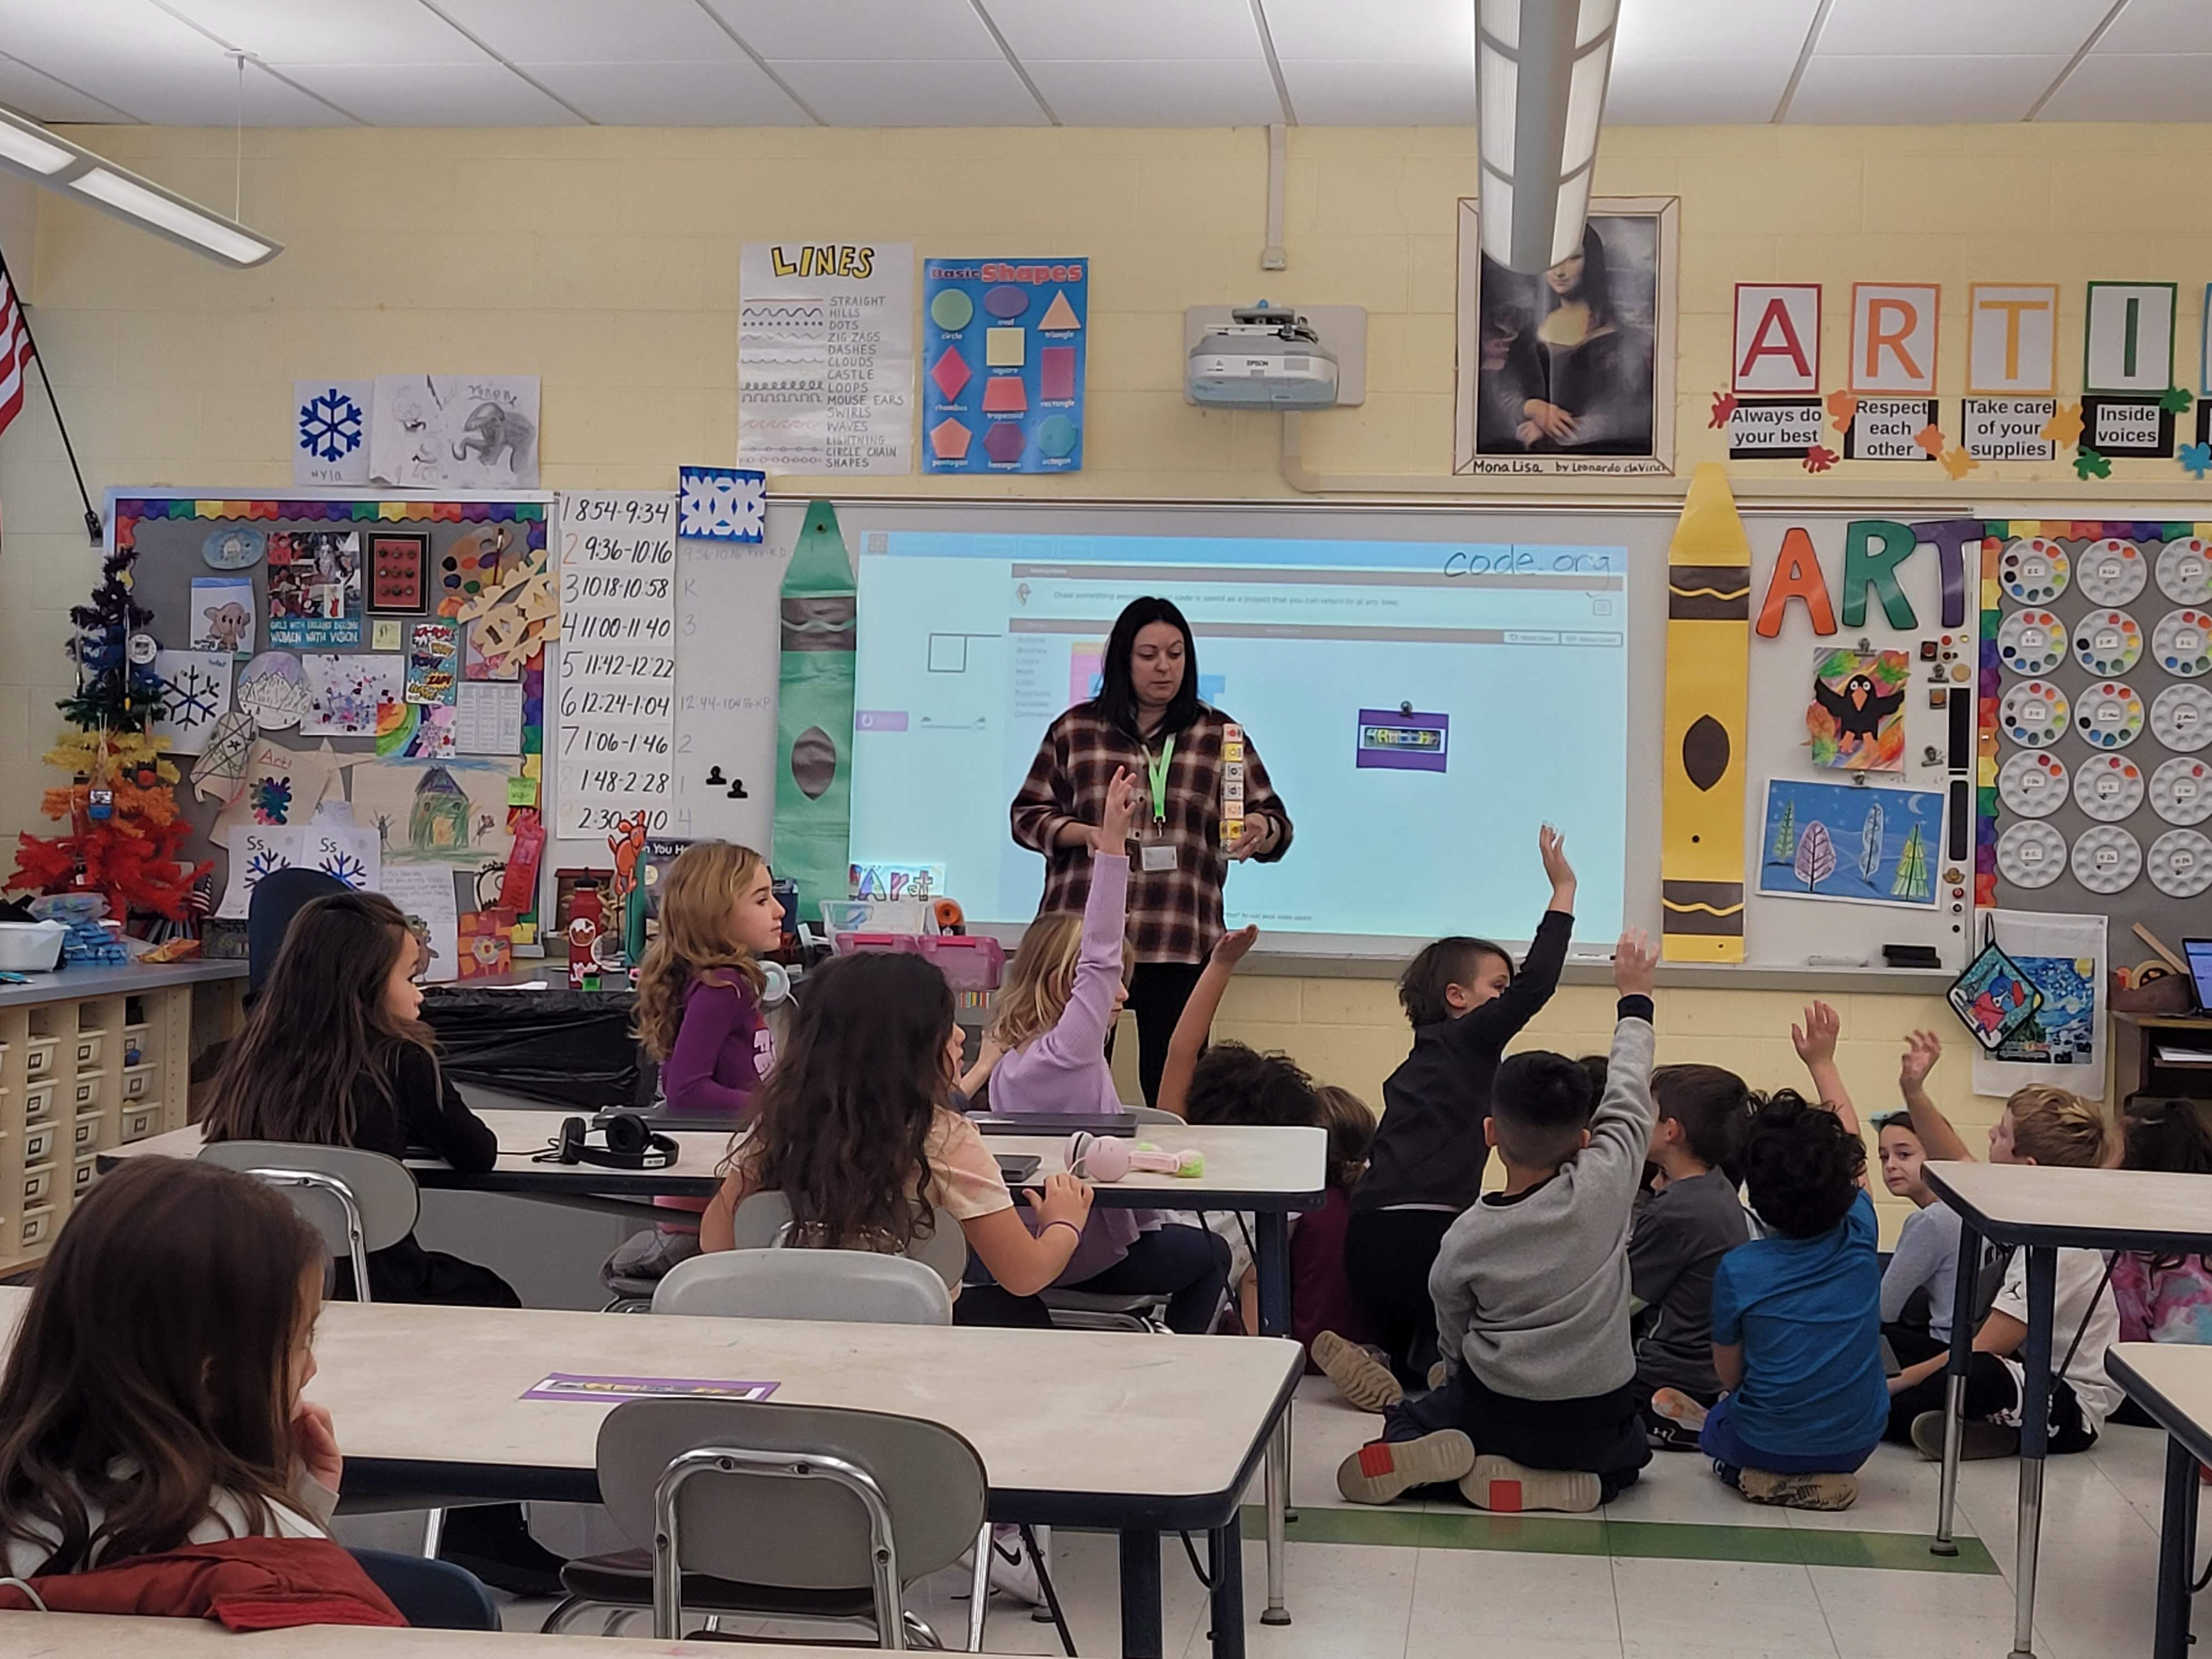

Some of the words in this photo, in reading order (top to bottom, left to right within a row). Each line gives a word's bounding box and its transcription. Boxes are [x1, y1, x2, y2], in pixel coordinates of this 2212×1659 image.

[771, 245, 874, 279] LINES
[930, 267, 980, 280] Basic
[981, 263, 1083, 285] Shapes
[830, 296, 886, 306] STRAIGHT
[830, 308, 860, 318] HILLS
[829, 320, 859, 330] DOTS
[1045, 330, 1074, 340] triangle
[1738, 298, 1813, 377] A
[1866, 298, 1925, 379] R
[1979, 301, 2049, 380] T
[2124, 298, 2140, 377] I
[828, 345, 877, 356] DASHES
[827, 357, 873, 367] CLOUDS
[827, 369, 874, 380] CASTLE
[828, 382, 868, 393] LOOPS
[827, 394, 867, 405] MOUSE
[874, 394, 904, 406] EARS
[1040, 399, 1075, 409] rectangle
[1967, 400, 2008, 414] Take
[2014, 402, 2052, 414] care
[827, 407, 871, 419] SWIRLS
[1855, 400, 1927, 417] Respect
[2101, 407, 2155, 421] Inside
[987, 412, 1024, 421] trapezoid
[1731, 409, 1795, 425] Always
[1800, 409, 1822, 422] do
[827, 421, 868, 432] WAVES
[1870, 422, 1912, 436] each
[1978, 421, 1996, 435] of
[2000, 423, 2042, 438] your
[826, 435, 885, 445] LIGHTNING
[1735, 431, 1775, 446] your
[1781, 429, 1819, 443] best
[2098, 428, 2157, 442] voices
[826, 447, 861, 457] CIRCLE
[867, 447, 897, 457] CHAIN
[1867, 442, 1914, 456] other
[1970, 443, 2047, 459] supplies
[826, 458, 870, 467] SHAPES
[932, 458, 968, 467] pentagon
[1556, 461, 1570, 472] by
[1572, 462, 1621, 473] Leonardo
[562, 496, 570, 522] 1
[562, 533, 579, 565] 2
[1756, 519, 1985, 638] ART
[565, 574, 579, 602] 3
[684, 579, 699, 597] K
[561, 612, 577, 643] 4
[682, 614, 697, 635] 3
[270, 631, 302, 644] WOMEN
[306, 631, 327, 642] WITH
[562, 651, 584, 678] 5
[561, 686, 577, 716] 6
[561, 726, 580, 755] 7
[678, 735, 693, 753] 2
[247, 836, 264, 851] Ss
[320, 838, 337, 853] Ss
[653, 843, 673, 855] You
[857, 868, 933, 901] Art
